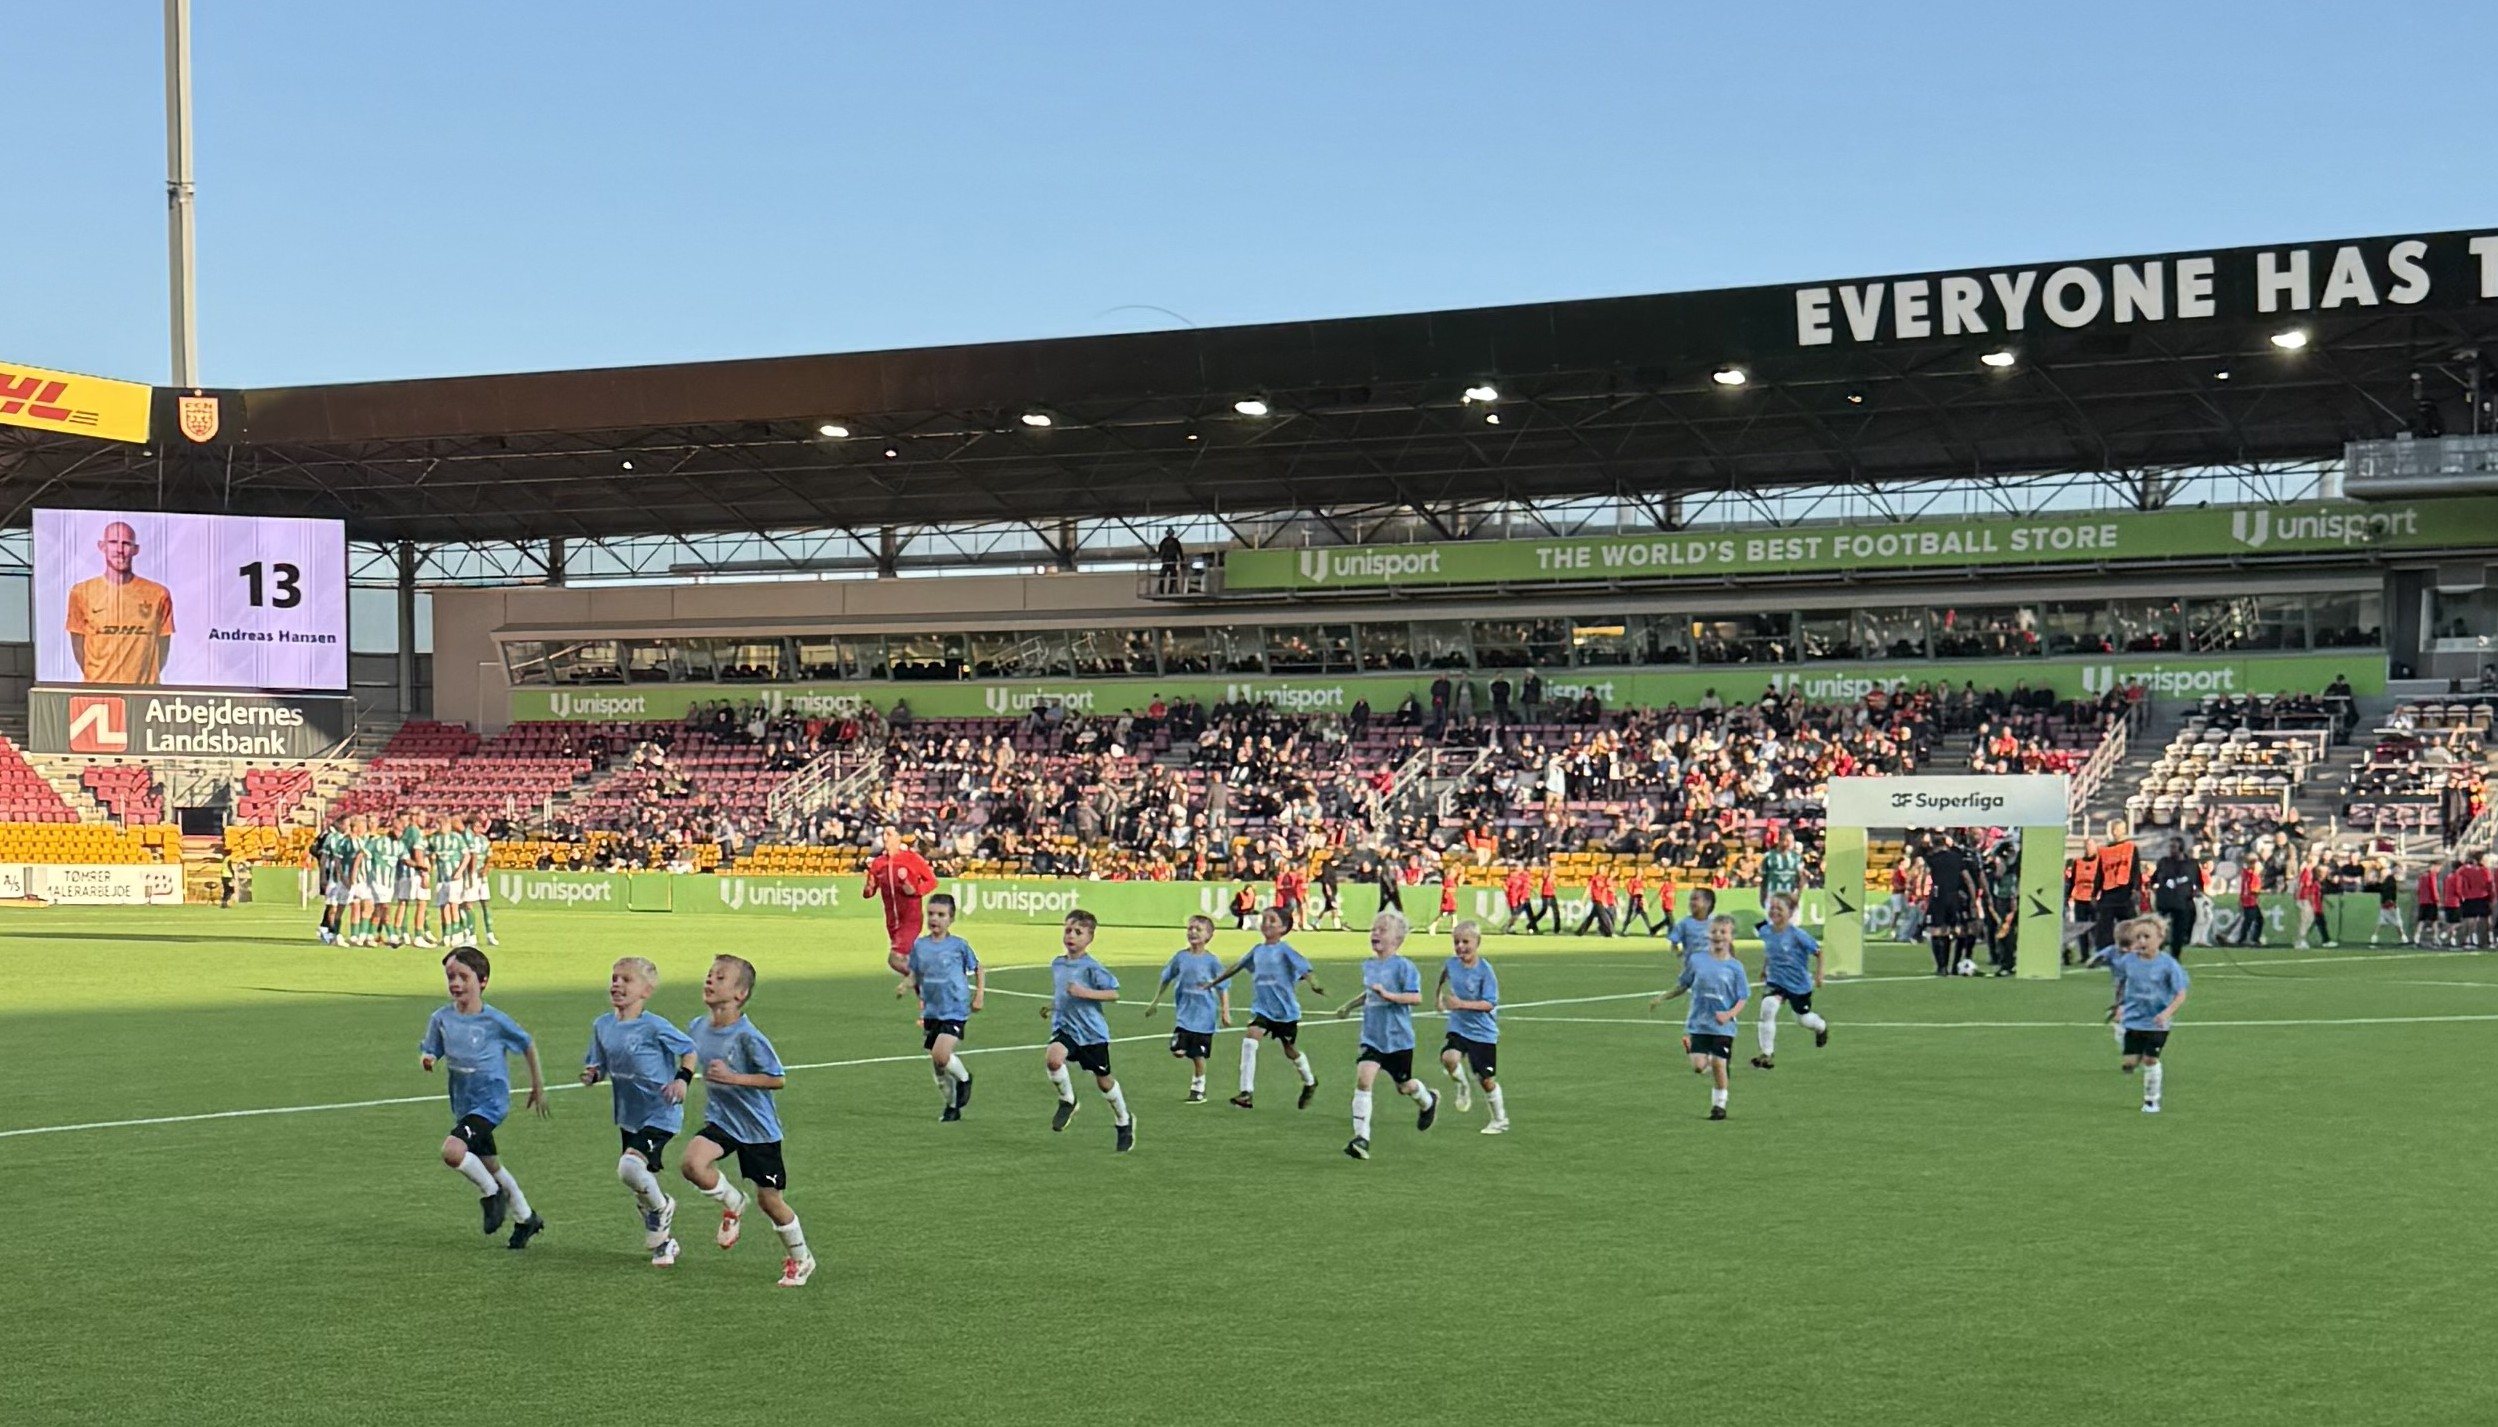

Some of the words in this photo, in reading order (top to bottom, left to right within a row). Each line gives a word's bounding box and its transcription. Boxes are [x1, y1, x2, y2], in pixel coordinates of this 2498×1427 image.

[1796, 257, 2215, 346] EVERYONE
[2257, 240, 2431, 312] HAS
[1335, 548, 1440, 582] unisport
[1536, 546, 1591, 569] THE
[1602, 540, 1735, 567] WORLD'S
[1746, 537, 1822, 562] BEST
[1833, 529, 1998, 559] FOOTBALL
[2010, 524, 2118, 551] STORE
[239, 561, 301, 608] 13
[209, 628, 273, 642] Andreas
[279, 630, 336, 644] Hansen
[145, 698, 303, 730] Arbejdernes
[574, 693, 645, 718] unisport
[146, 728, 286, 755] Landsbank
[1892, 793, 1912, 807] 3F
[1916, 792, 2004, 811] Superliga
[527, 877, 611, 906] unisport
[750, 880, 839, 911] unisport
[982, 884, 1079, 917] unisport
